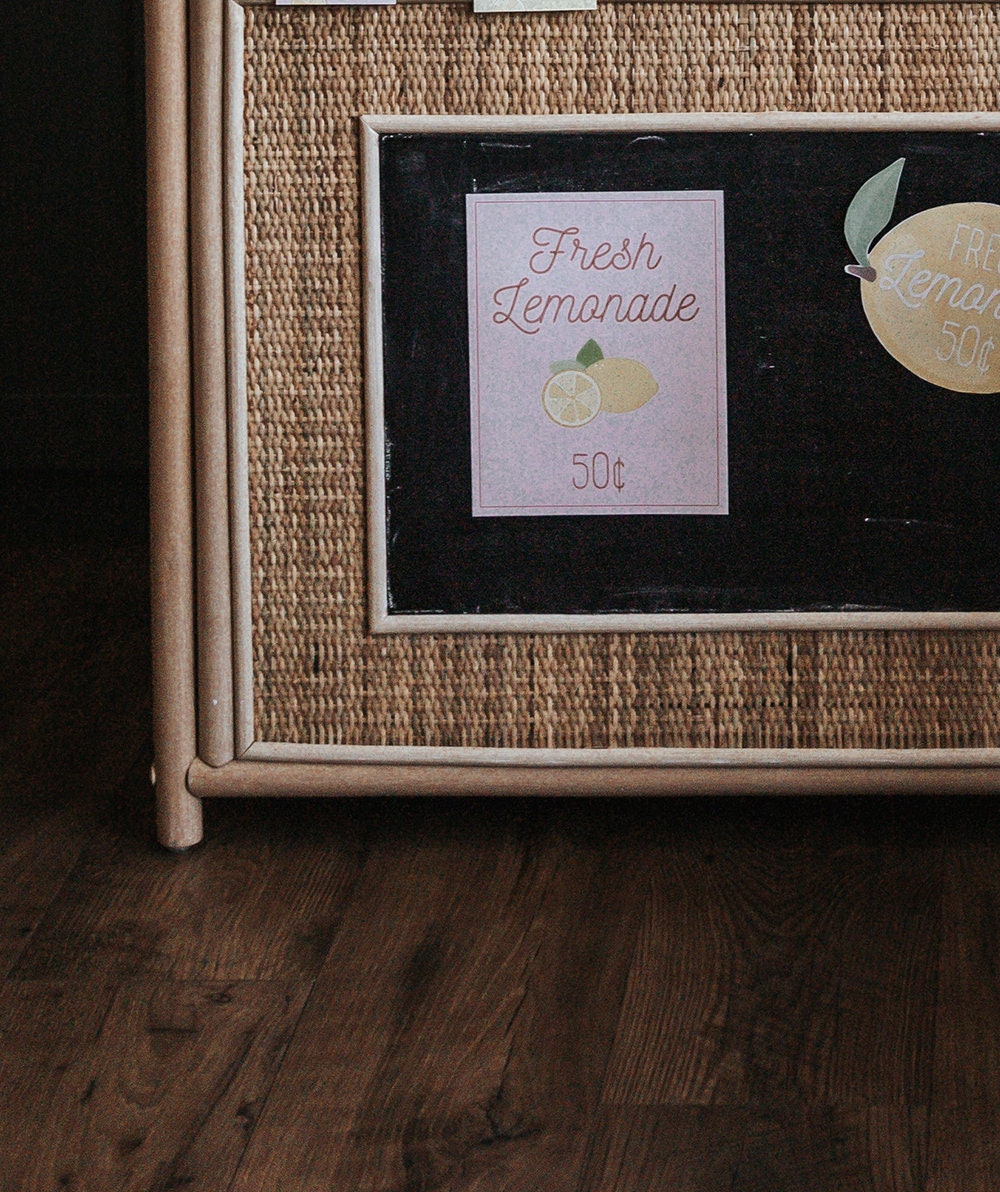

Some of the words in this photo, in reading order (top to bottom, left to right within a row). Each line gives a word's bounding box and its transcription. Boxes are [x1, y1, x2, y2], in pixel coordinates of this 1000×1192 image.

[529, 226, 662, 274] Fresh
[492, 277, 700, 335] Lemonade
[936, 320, 996, 376] 50¢
[572, 451, 625, 493] 50¢
